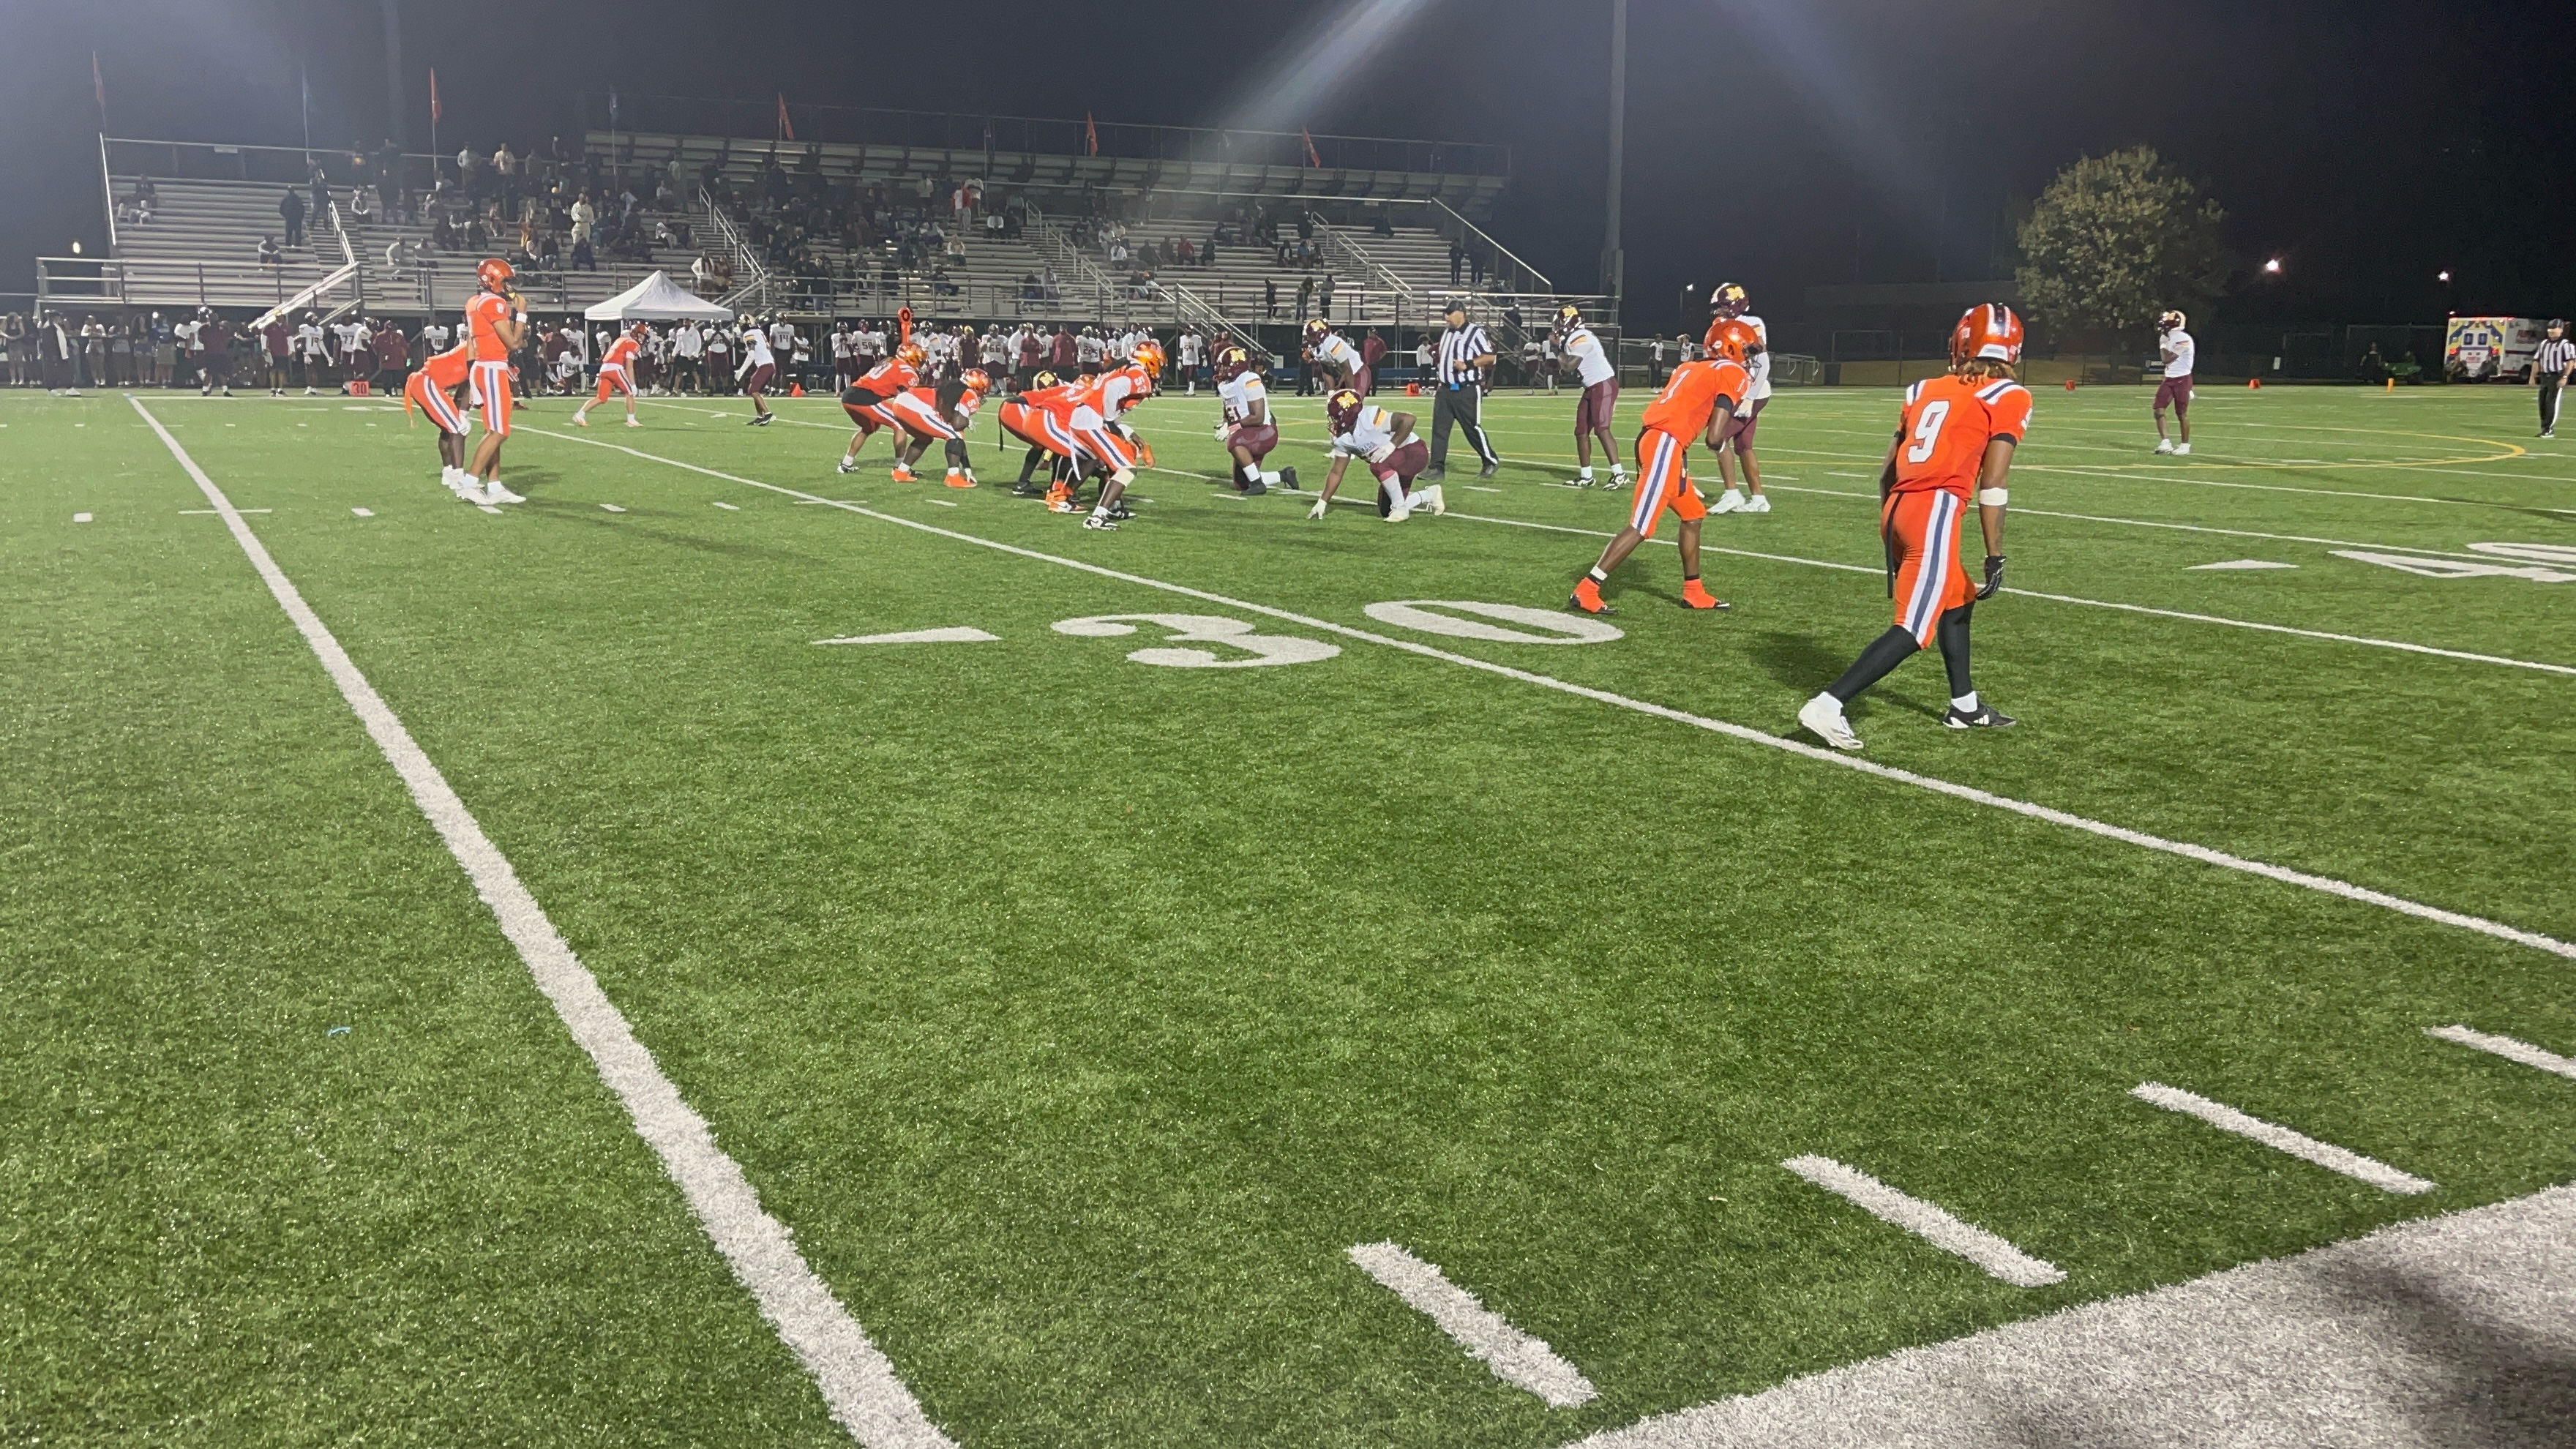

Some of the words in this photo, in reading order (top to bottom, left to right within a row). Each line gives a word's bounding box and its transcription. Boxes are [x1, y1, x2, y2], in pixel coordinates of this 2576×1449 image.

[495, 302, 505, 314] 8
[989, 344, 1001, 353] 66
[353, 383, 367, 394] 30
[1134, 375, 1147, 394] 53
[1658, 368, 1692, 405] 1
[1737, 378, 1745, 393] 1
[1906, 399, 1952, 465] 9
[1049, 599, 1625, 668] 30
